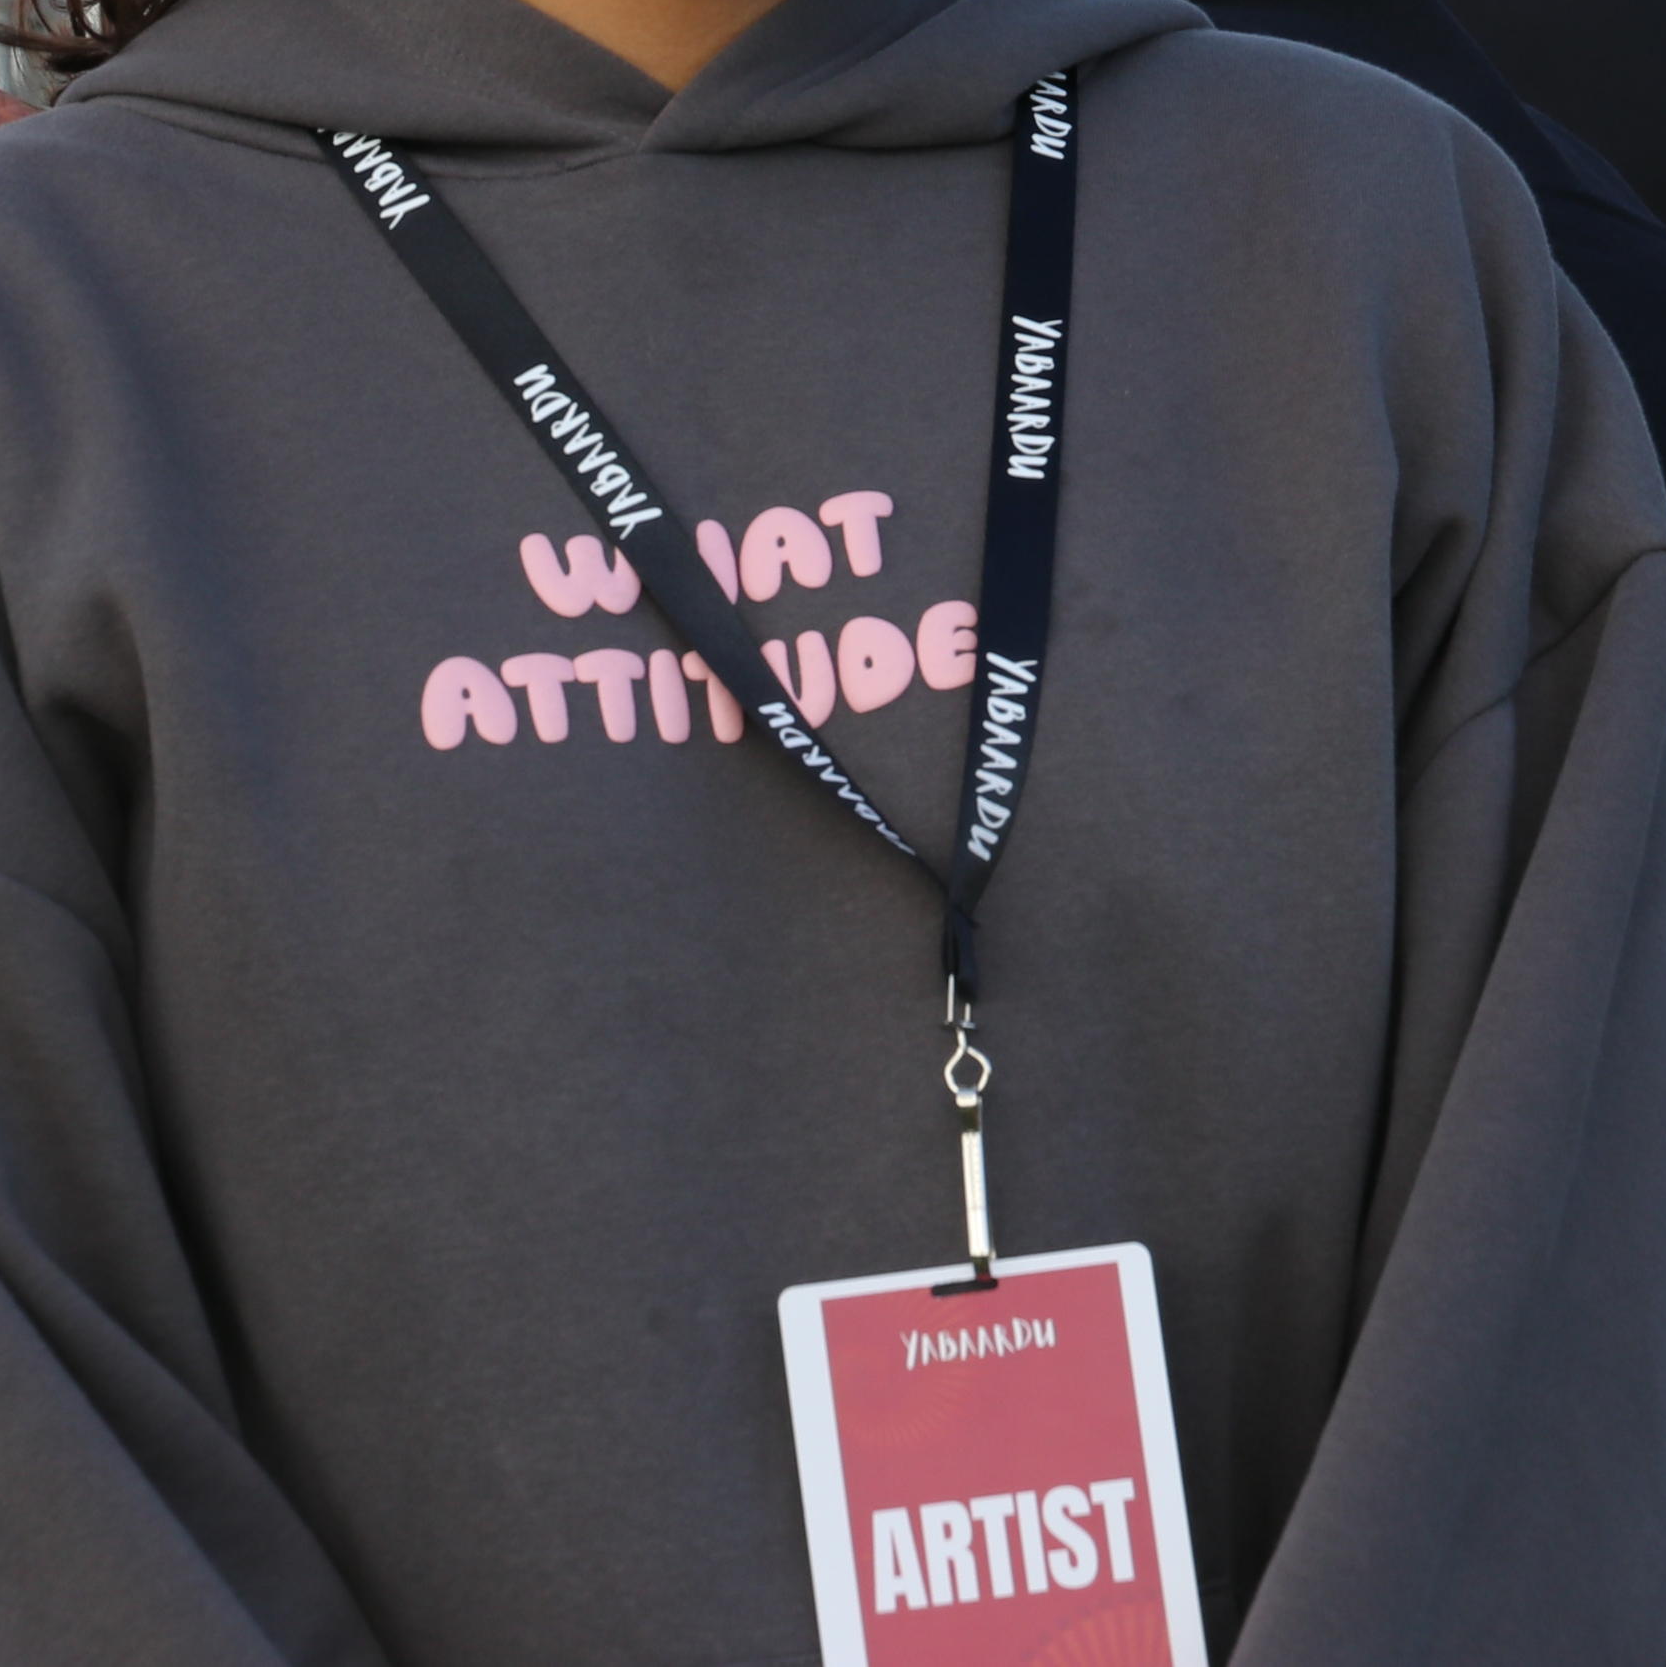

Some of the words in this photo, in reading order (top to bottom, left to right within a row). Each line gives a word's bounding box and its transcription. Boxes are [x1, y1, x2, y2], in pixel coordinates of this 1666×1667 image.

[513, 363, 663, 540] YABAARDU
[1006, 315, 1064, 480] YABAARDU
[421, 600, 979, 751] ATTITUDE
[967, 651, 1039, 862] YABAARDU
[899, 1316, 1057, 1371] YABAARDU
[871, 1477, 1136, 1615] ARTIST
